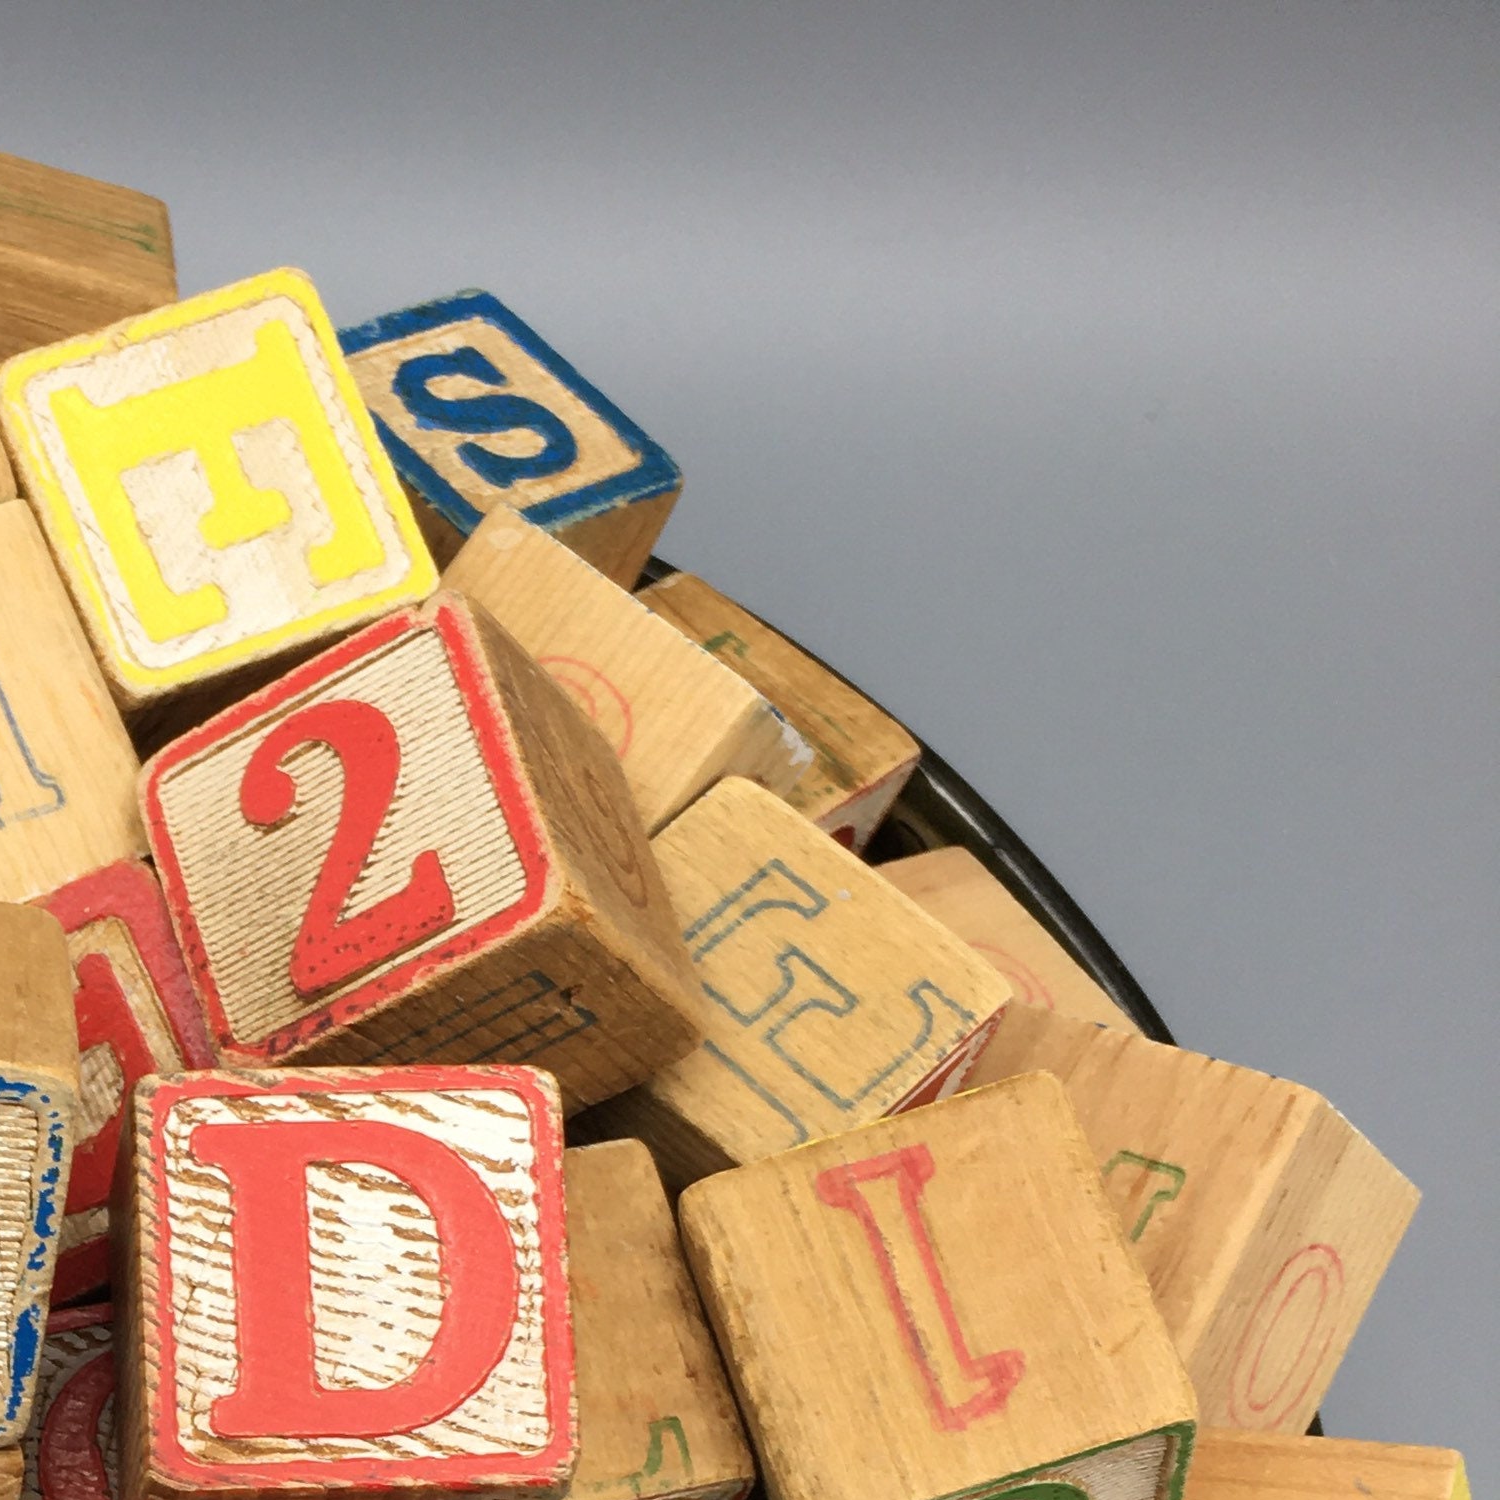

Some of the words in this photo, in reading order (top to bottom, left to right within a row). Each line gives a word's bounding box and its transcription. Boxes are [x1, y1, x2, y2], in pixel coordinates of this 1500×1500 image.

[49, 317, 386, 643] E
[390, 347, 578, 488] S
[240, 699, 456, 999] 2
[189, 1120, 518, 1444] D
[817, 1143, 1027, 1432] I
